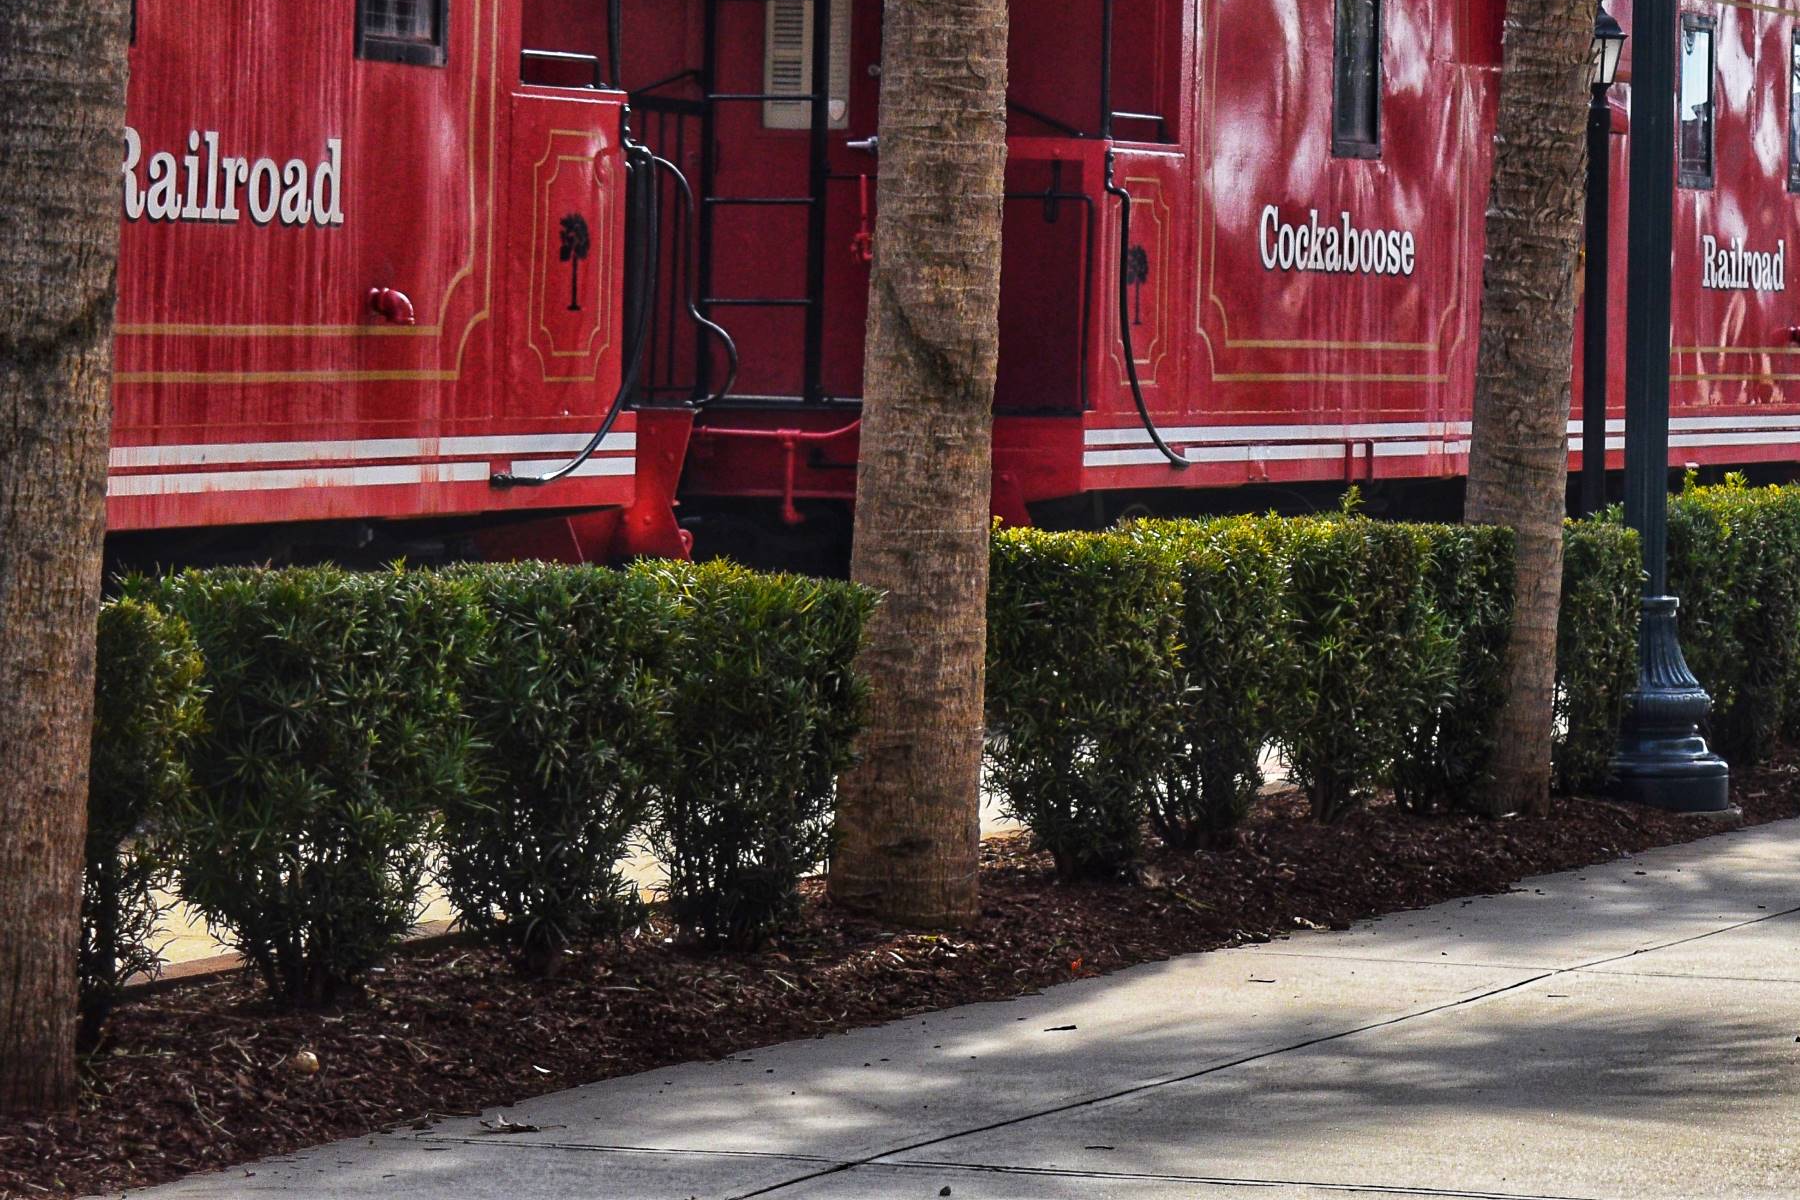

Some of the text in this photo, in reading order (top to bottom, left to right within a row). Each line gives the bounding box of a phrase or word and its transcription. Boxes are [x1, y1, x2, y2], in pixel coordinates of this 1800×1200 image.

[122, 126, 345, 226] Railroad
[1260, 204, 1415, 275] Cockaboose
[1702, 234, 1785, 291] Railroad
